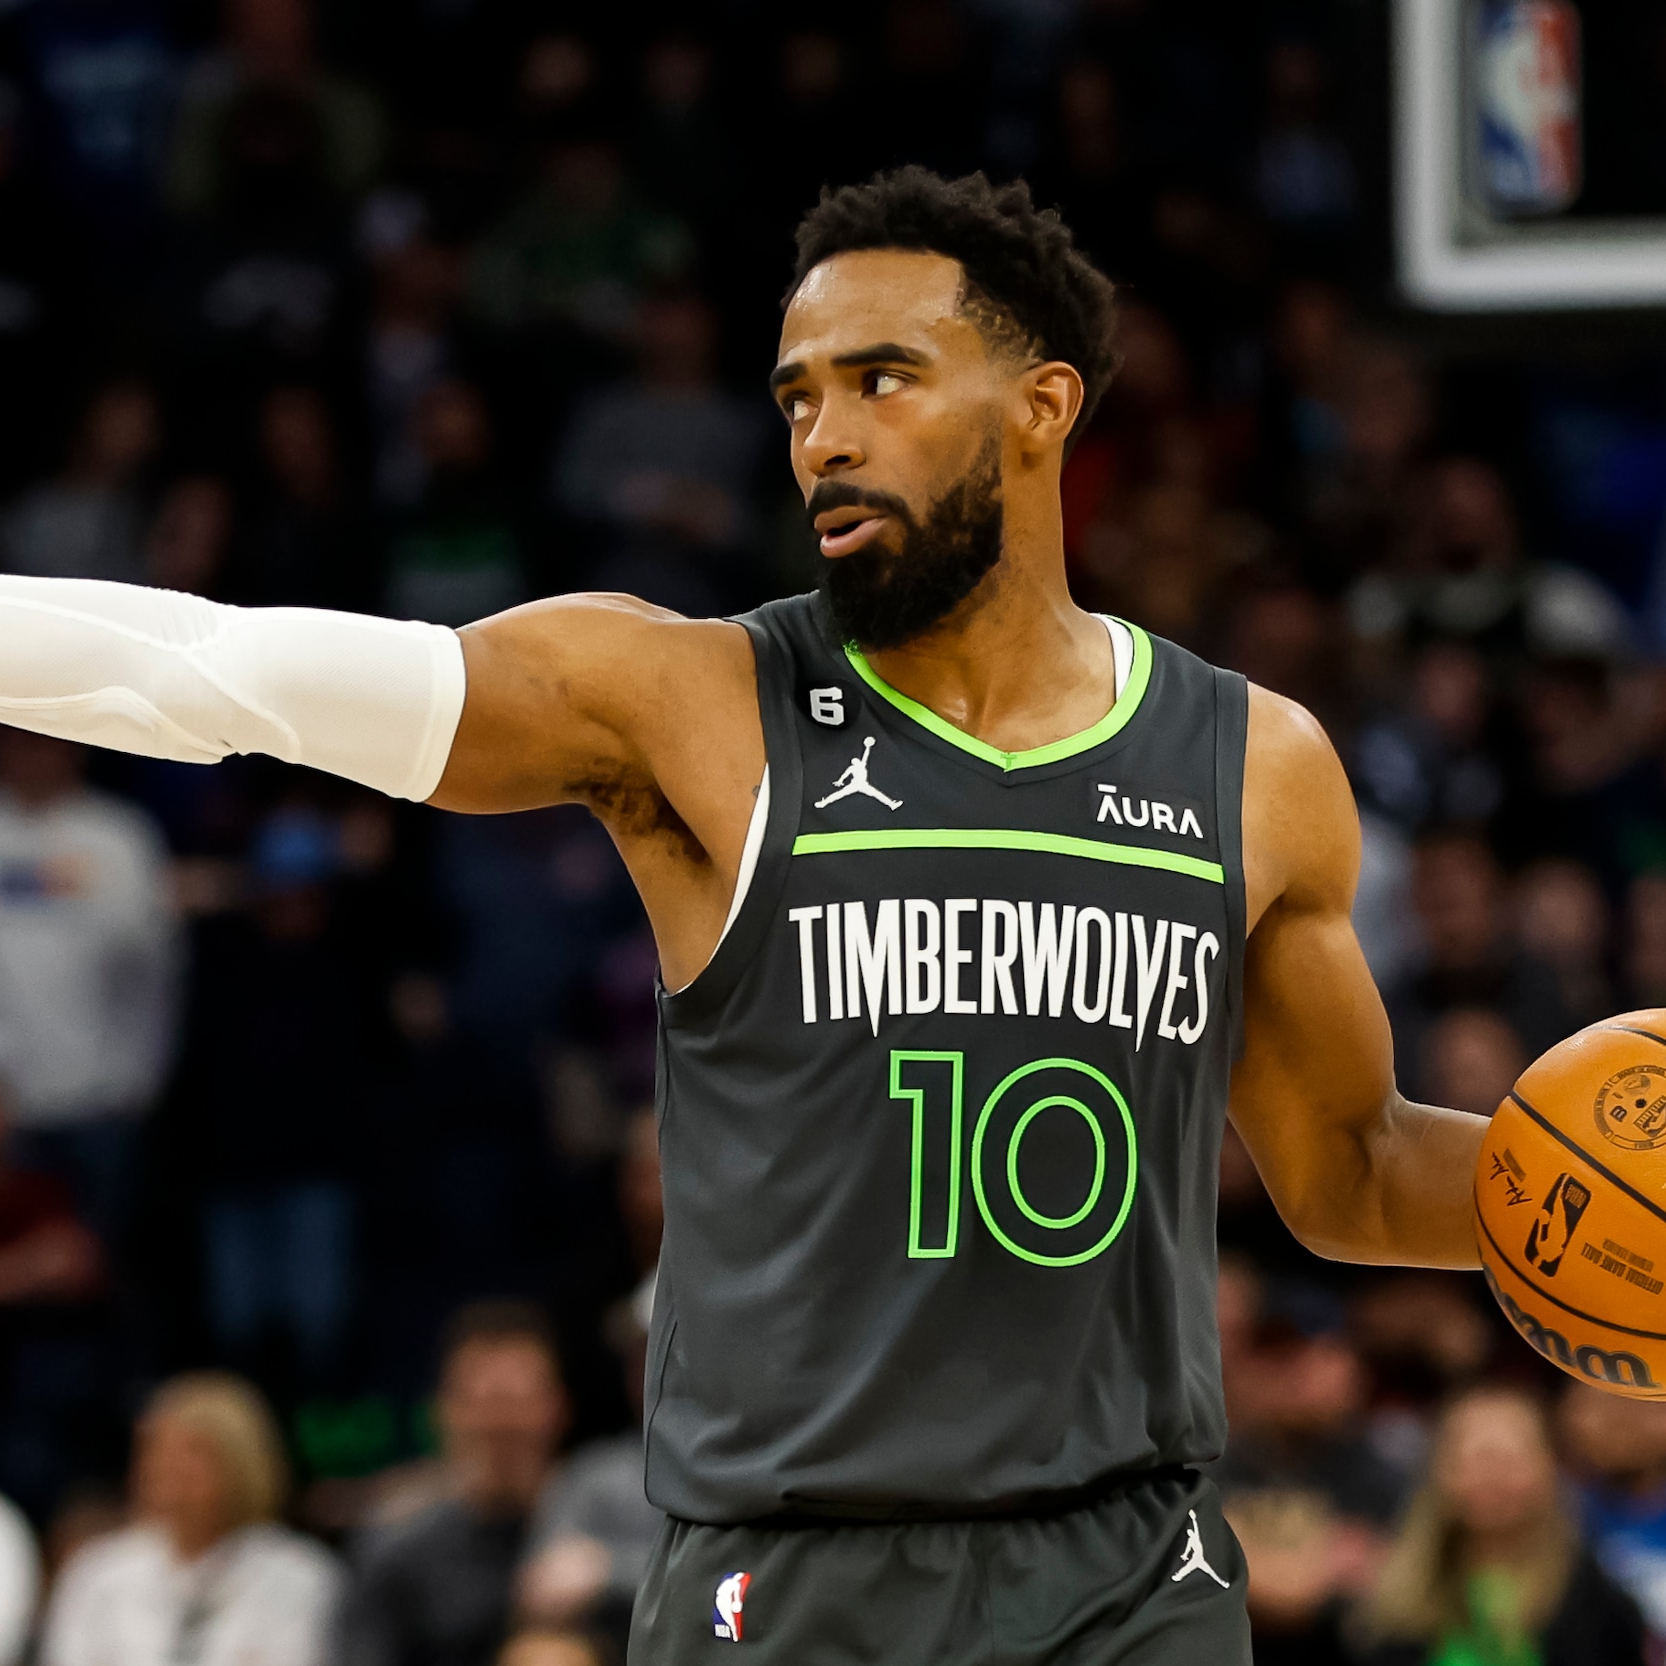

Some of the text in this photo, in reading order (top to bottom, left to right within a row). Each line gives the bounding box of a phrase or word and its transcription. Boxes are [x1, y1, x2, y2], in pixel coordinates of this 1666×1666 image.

[809, 686, 845, 726] 6
[789, 898, 1220, 1052] TIMBERWOLVES
[889, 1049, 1137, 1268] 10
